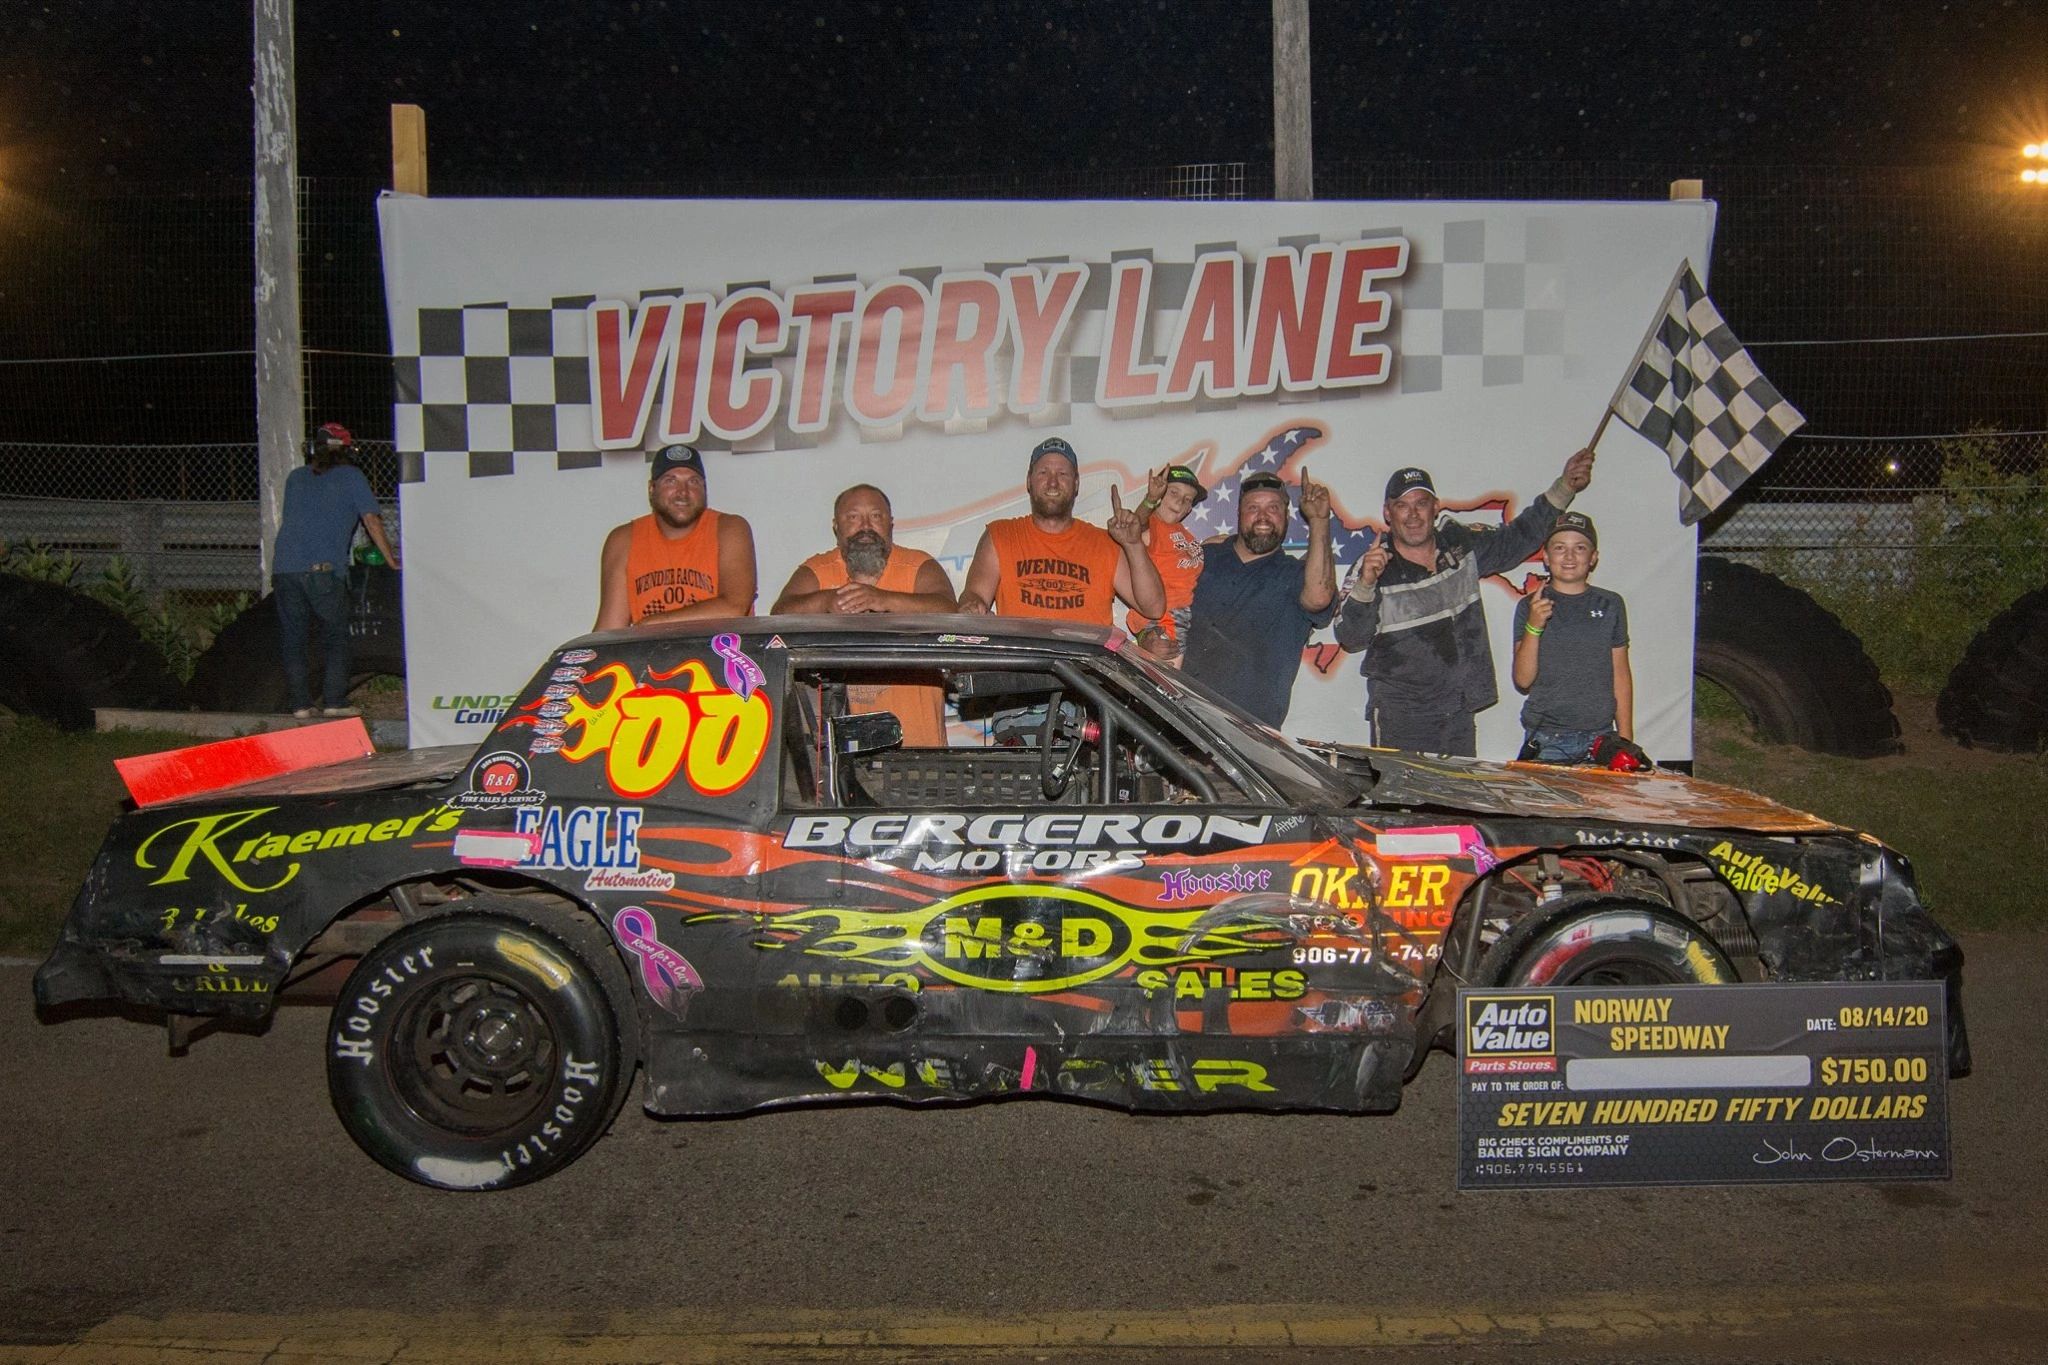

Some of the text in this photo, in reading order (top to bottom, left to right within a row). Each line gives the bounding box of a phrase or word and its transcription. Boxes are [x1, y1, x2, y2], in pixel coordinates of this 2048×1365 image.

[588, 237, 1410, 449] VICTORY LANE
[635, 568, 714, 596] WENDER RACING
[1016, 558, 1091, 585] WENDER
[1020, 589, 1085, 610] RACING
[606, 686, 773, 799] 00
[486, 773, 516, 786] R & R
[782, 813, 1274, 846] BERGERON
[135, 804, 464, 893] Kraemer's
[912, 849, 1147, 871] MOTORS
[586, 868, 674, 888] Automotive
[1156, 864, 1272, 901] Hoosier
[336, 945, 433, 1066] Hoosier
[1476, 1002, 1547, 1026] Auto
[1574, 998, 1673, 1025] NORWAY
[1806, 1006, 1929, 1032] DATE: 08/14/20
[1471, 1026, 1549, 1050] Value
[1610, 1025, 1731, 1052] SPEEDWAY
[1470, 1060, 1505, 1071] Parts
[1821, 1056, 1928, 1086] $750.00
[1471, 1080, 1564, 1092] PAY TO THE ORDER OF:
[502, 1051, 599, 1172] Hoosier
[1498, 1094, 1928, 1127] SEVEN HUNDRED FIFTY DOLLARS
[1478, 1135, 1631, 1147] BIG CHECK COMPLIMENTS OF
[1478, 1145, 1629, 1159] BAKER SIGN COMPANY
[1753, 1136, 1939, 1165] John Ostermann
